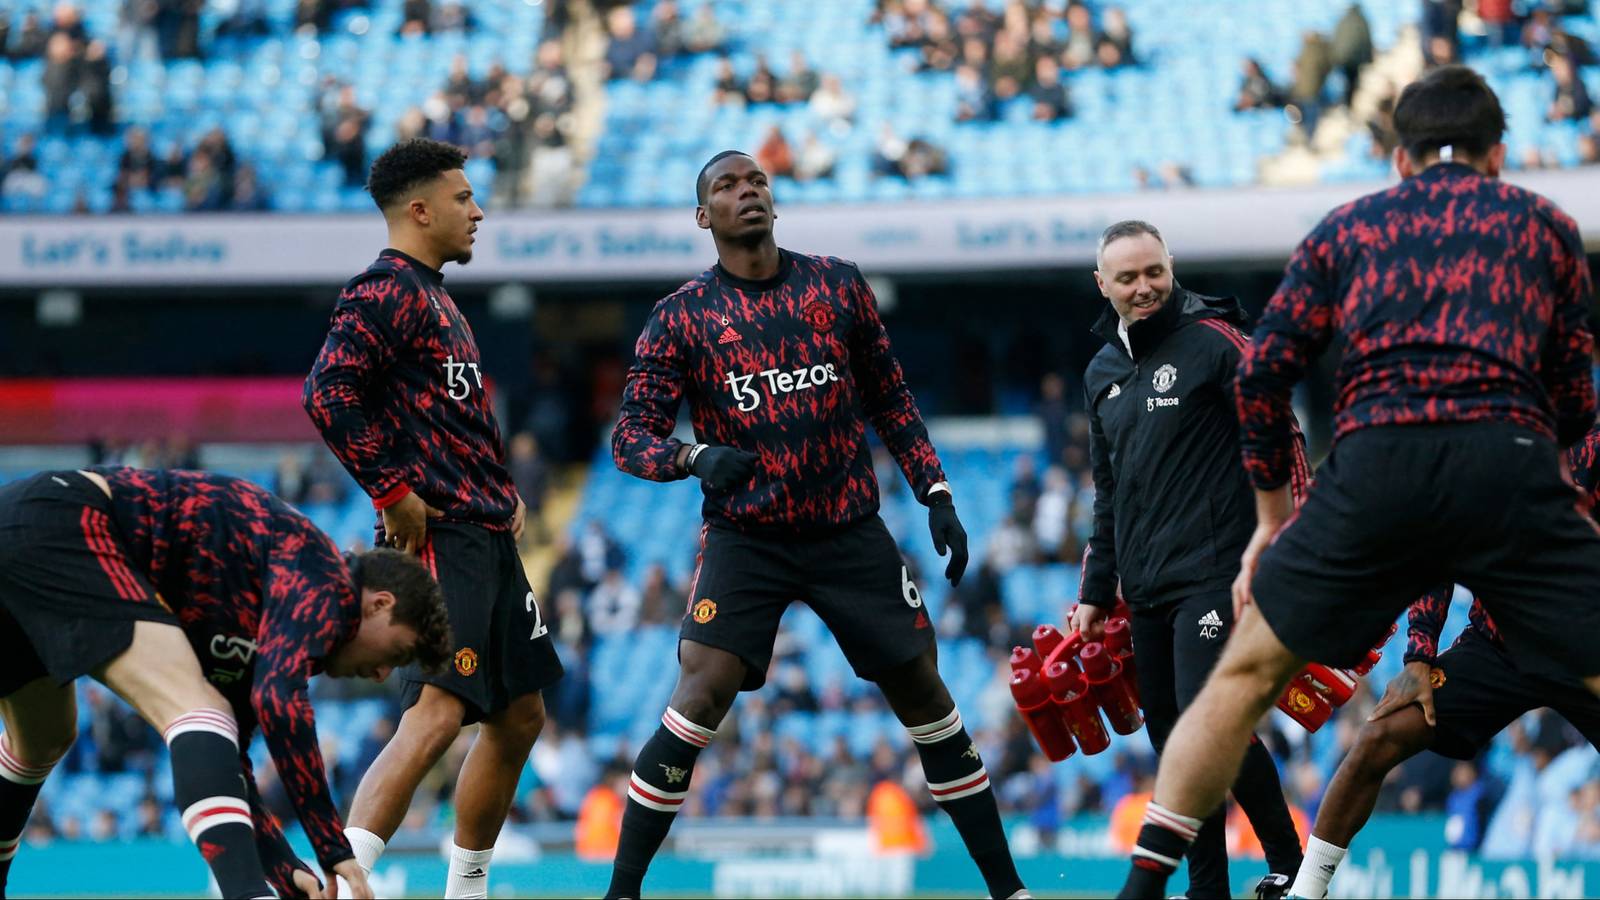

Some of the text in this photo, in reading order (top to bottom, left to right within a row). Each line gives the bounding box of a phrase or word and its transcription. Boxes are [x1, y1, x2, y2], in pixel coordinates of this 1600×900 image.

[721, 314, 730, 326] 6
[718, 334, 743, 345] adidas
[760, 363, 838, 395] Tezos
[1155, 397, 1179, 407] Tezos
[901, 565, 922, 608] 6
[525, 591, 548, 640] 2
[1198, 619, 1223, 627] adidas
[1200, 625, 1218, 640] AC
